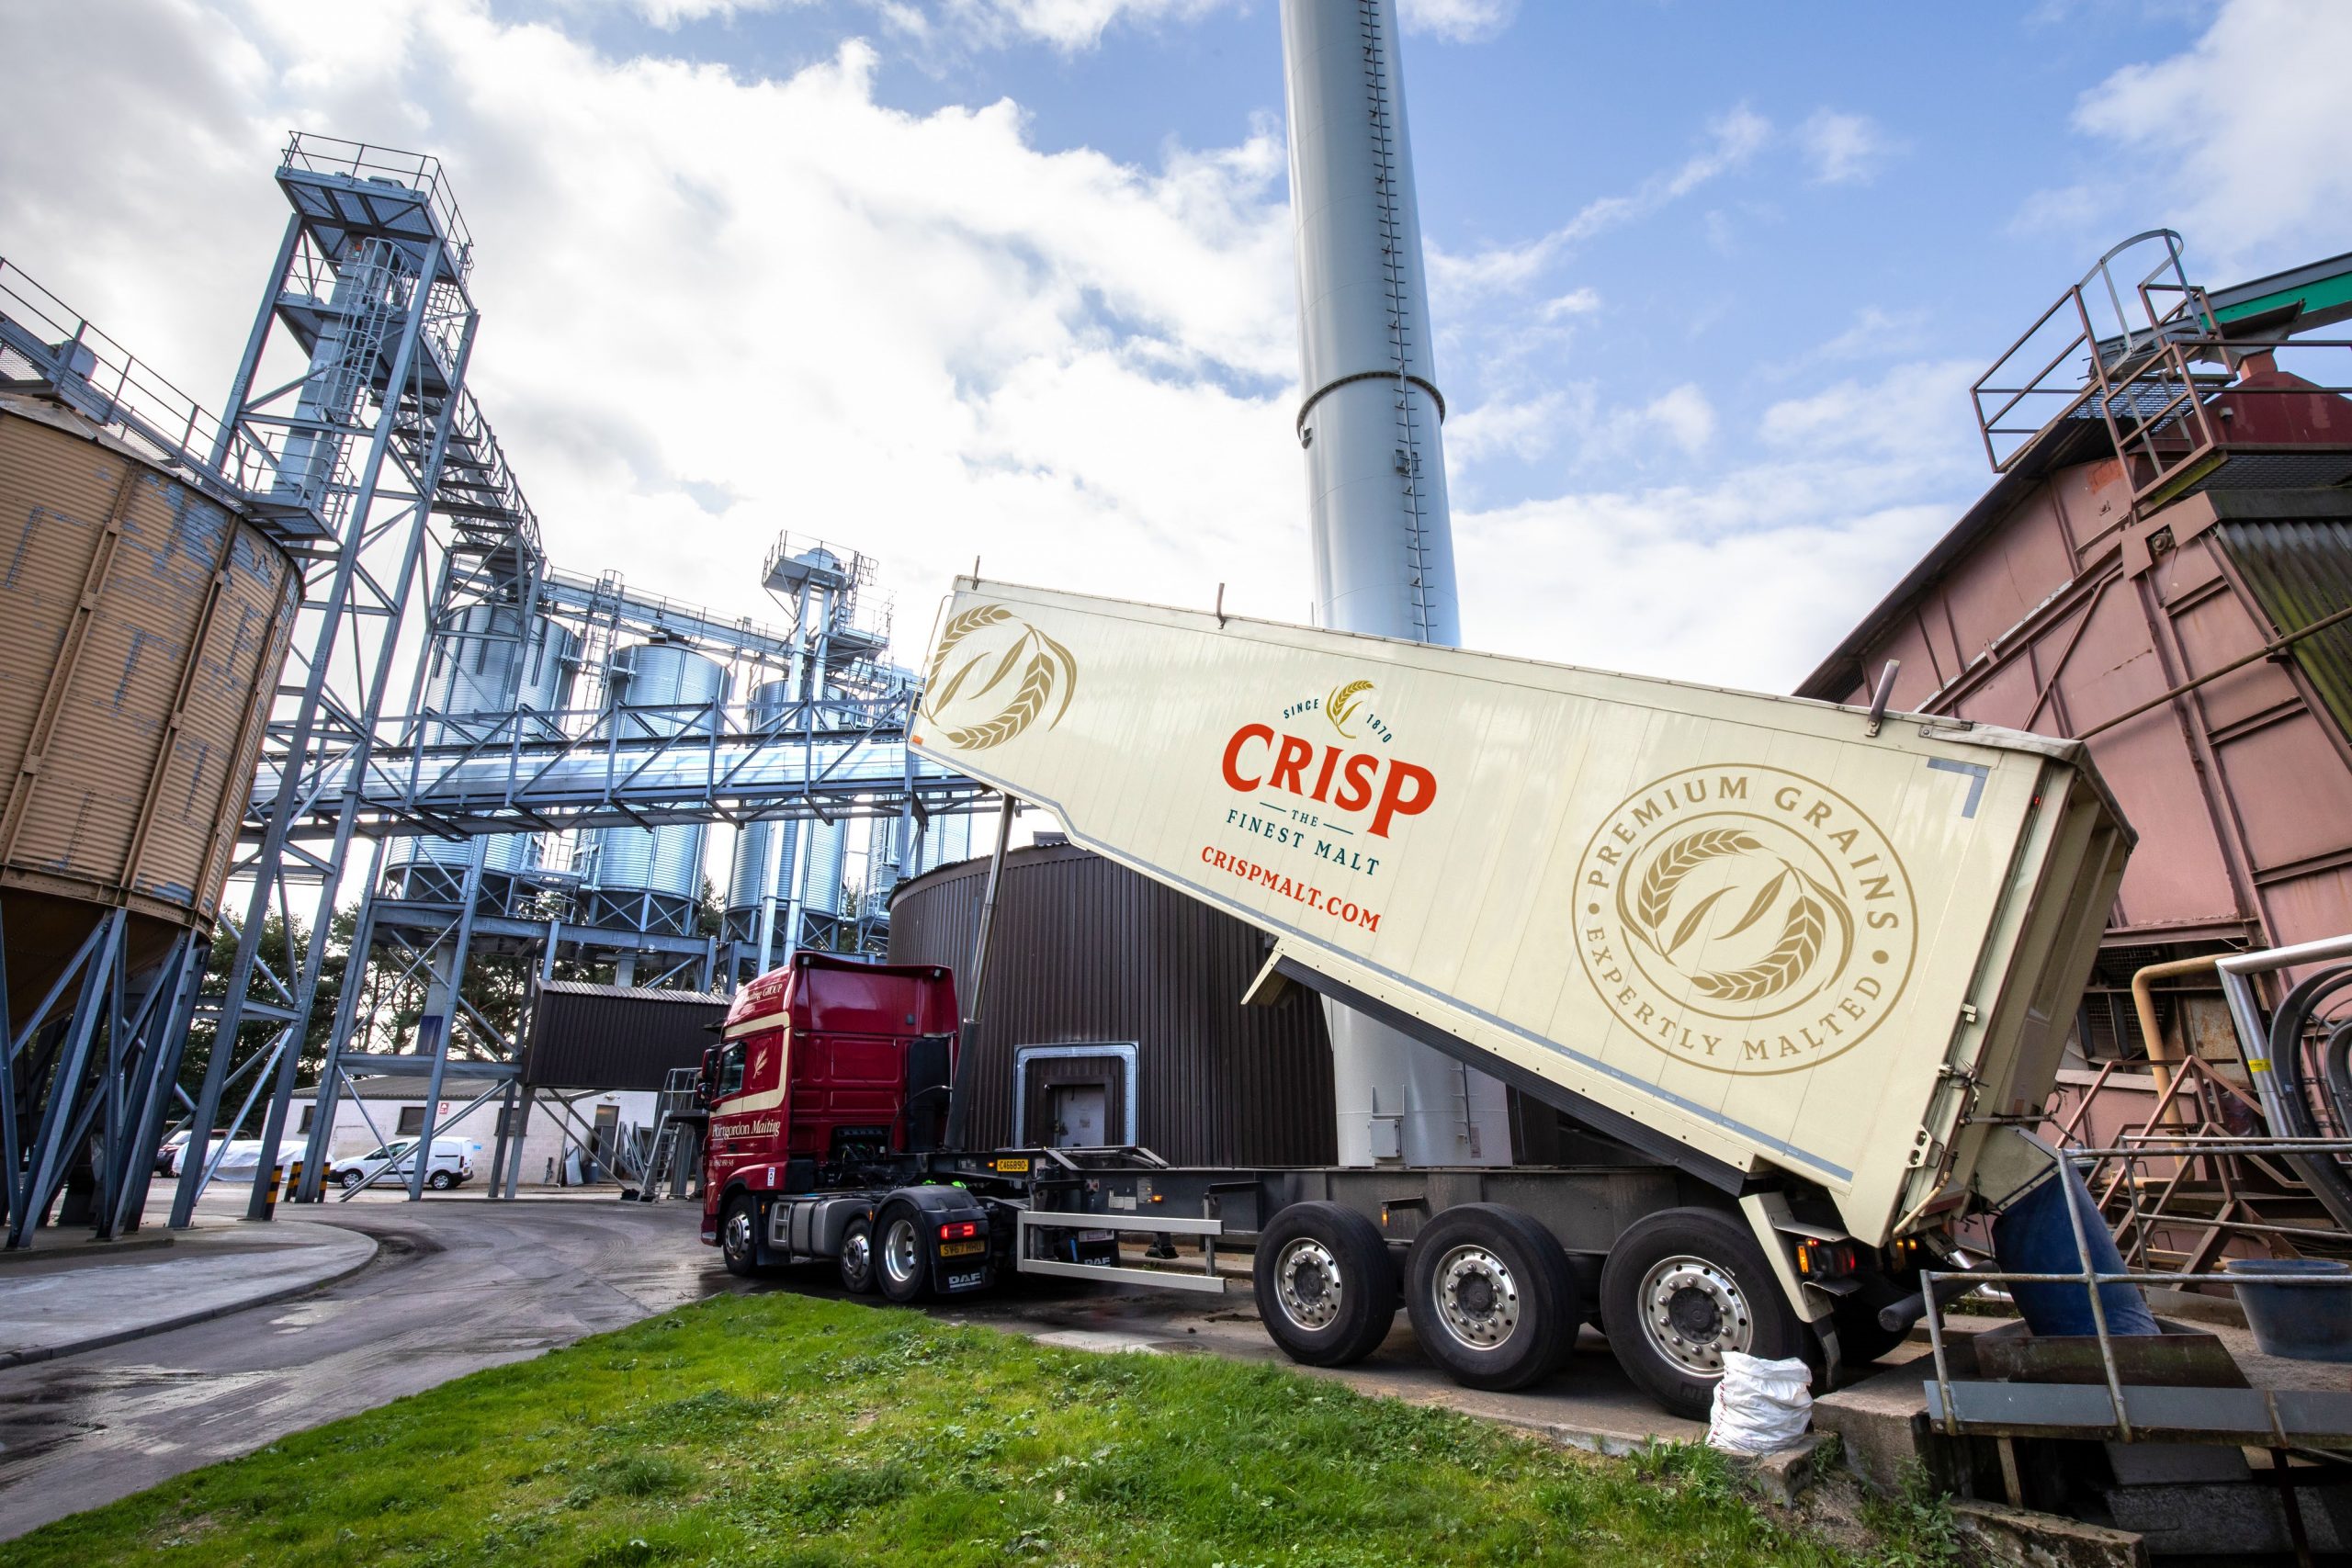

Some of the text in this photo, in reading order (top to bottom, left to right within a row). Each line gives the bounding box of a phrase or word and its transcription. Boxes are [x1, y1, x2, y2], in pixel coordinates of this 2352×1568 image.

[1283, 698, 1393, 743] SINCE 1870
[1222, 723, 1438, 839] CRISP
[1227, 808, 1380, 876] FINEST MALT
[1292, 809, 1318, 828] THE
[1587, 776, 1899, 931] PREMIUM GRAINS
[1201, 845, 1382, 933] CRISPMALT.COM
[1587, 927, 1882, 1060] EXPERTLY MALTED
[712, 1121, 750, 1140] Portgordon
[948, 1272, 981, 1284] DAF
